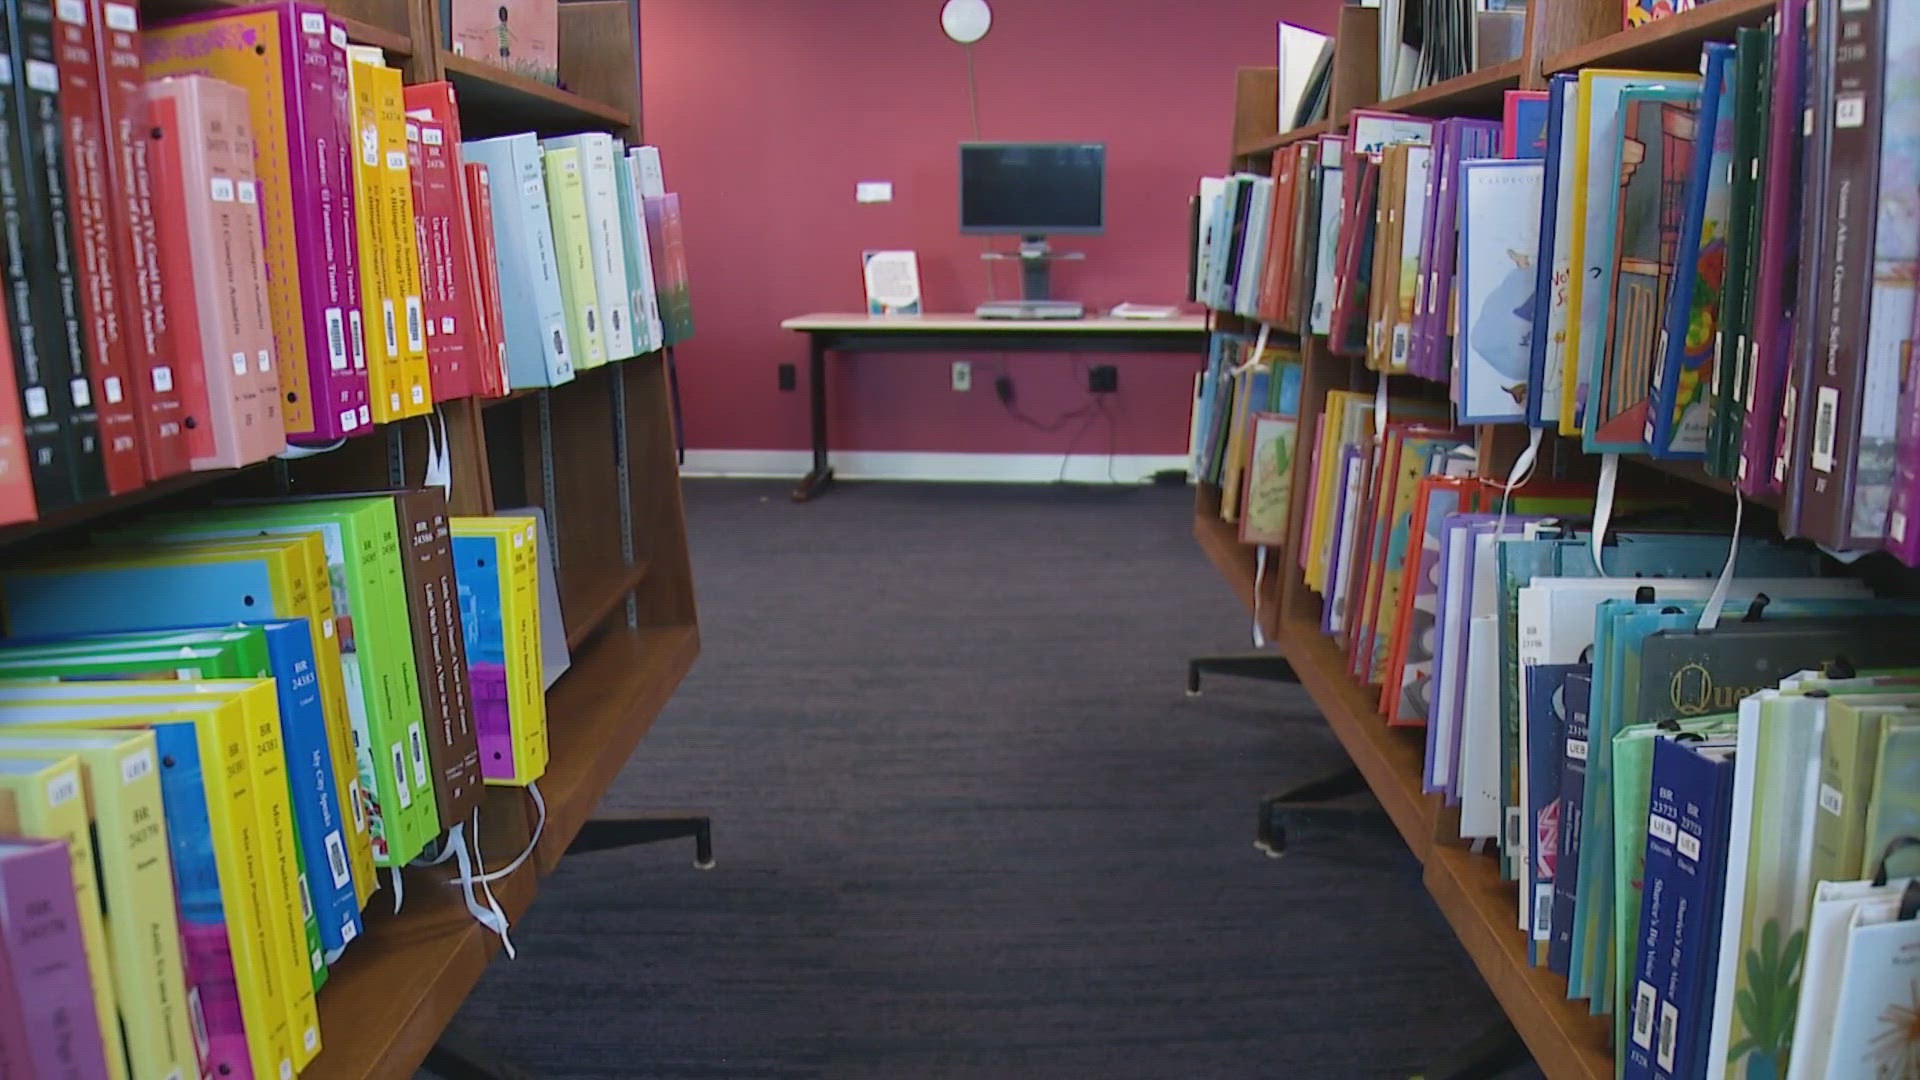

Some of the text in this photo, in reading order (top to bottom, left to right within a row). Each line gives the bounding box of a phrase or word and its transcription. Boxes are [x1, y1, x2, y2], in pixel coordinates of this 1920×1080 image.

[1832, 264, 1845, 303] Goes
[1827, 325, 1841, 377] School
[415, 521, 429, 533] BR
[294, 660, 308, 673] BR
[260, 723, 271, 737] BR
[1570, 743, 1586, 755] UEB
[313, 749, 321, 767] My
[1659, 786, 1674, 802] BR
[133, 806, 150, 823] BR
[1652, 800, 1678, 819] 23723
[1687, 802, 1700, 818] BR
[1654, 821, 1672, 835] UEB
